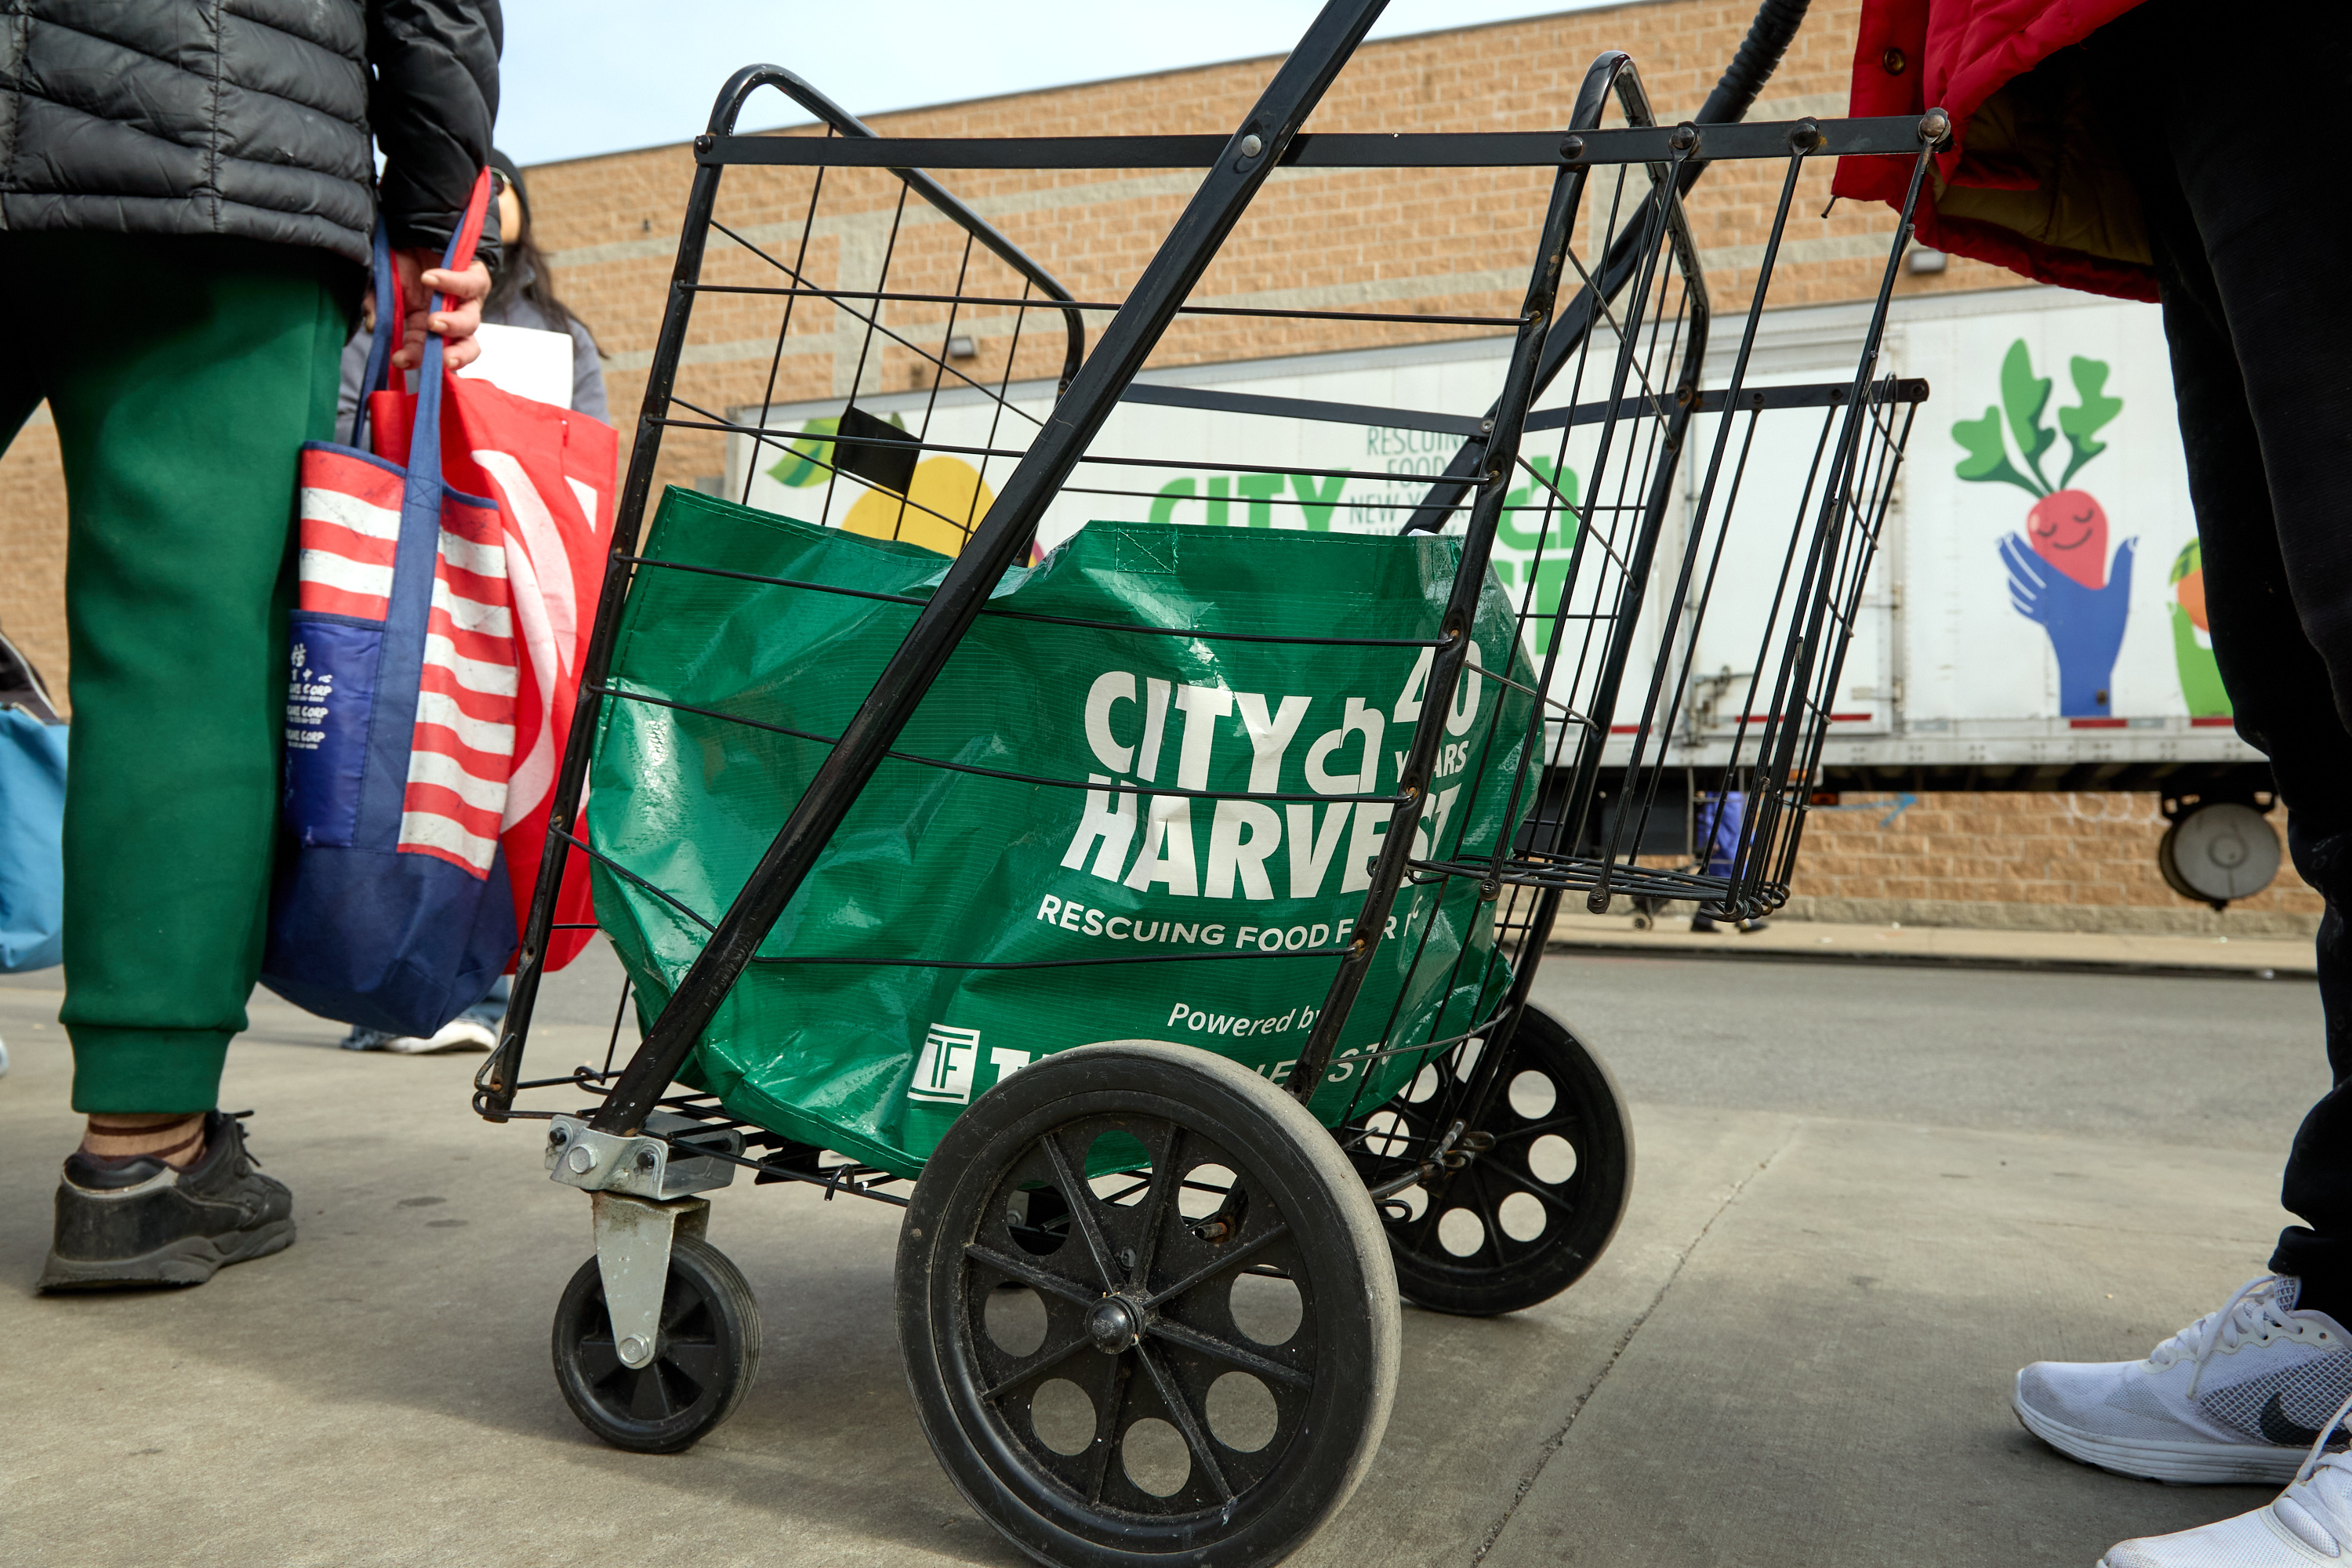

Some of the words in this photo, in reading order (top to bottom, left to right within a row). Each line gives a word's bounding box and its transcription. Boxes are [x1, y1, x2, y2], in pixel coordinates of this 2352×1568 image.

[1367, 426, 1467, 456] RESCUIN
[1349, 492, 1399, 524] NEW
[1084, 670, 1312, 793] CITY
[1395, 740, 1469, 783] YARS
[1036, 894, 1225, 945] RESCUING
[1235, 923, 1329, 951] FOOD
[1335, 916, 1397, 943] FR
[1167, 1003, 1296, 1036] Powered
